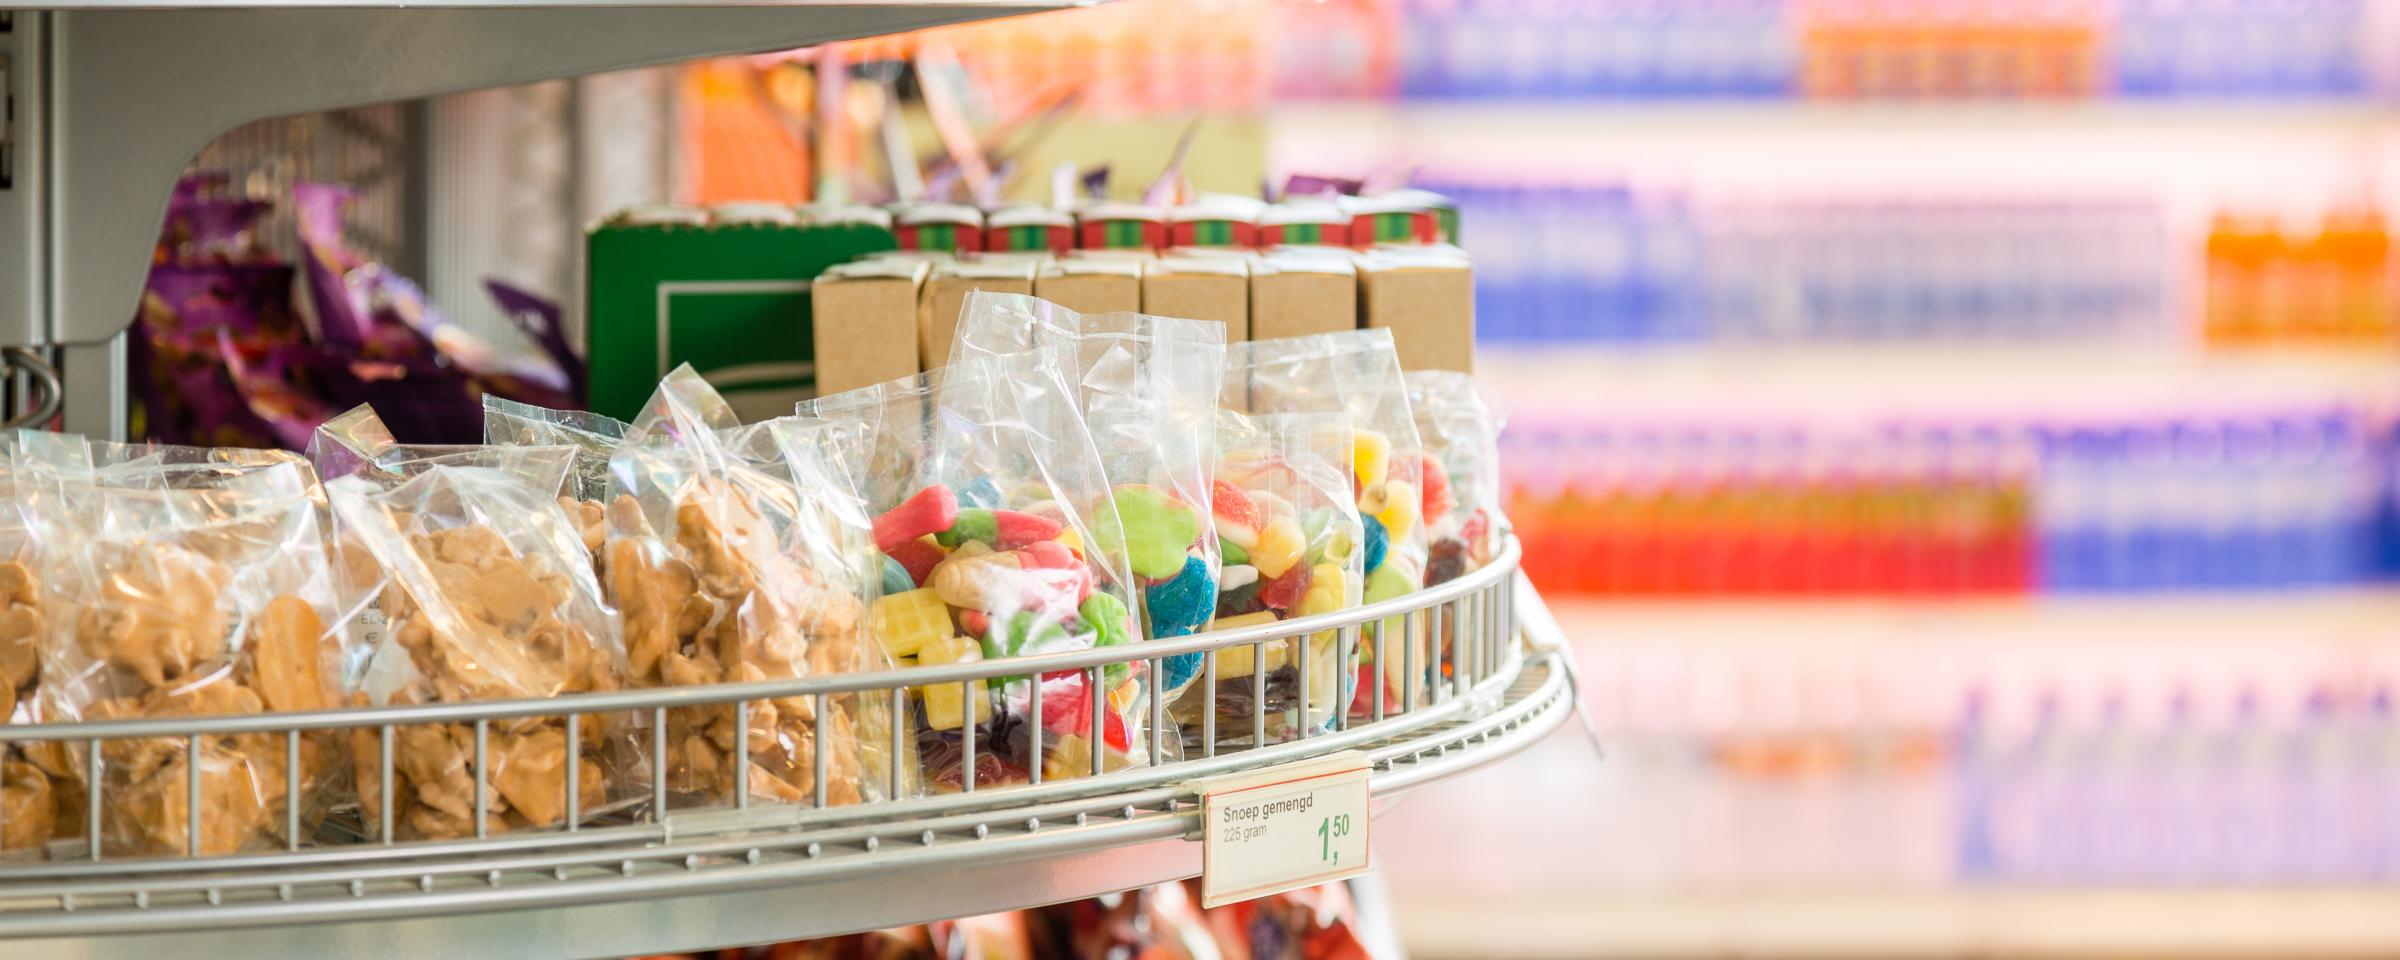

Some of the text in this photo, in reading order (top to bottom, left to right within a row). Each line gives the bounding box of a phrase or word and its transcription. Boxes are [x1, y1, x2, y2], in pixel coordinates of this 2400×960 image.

[1223, 792, 1313, 823] Snoep gemengd
[1223, 825, 1267, 843] 225 gram
